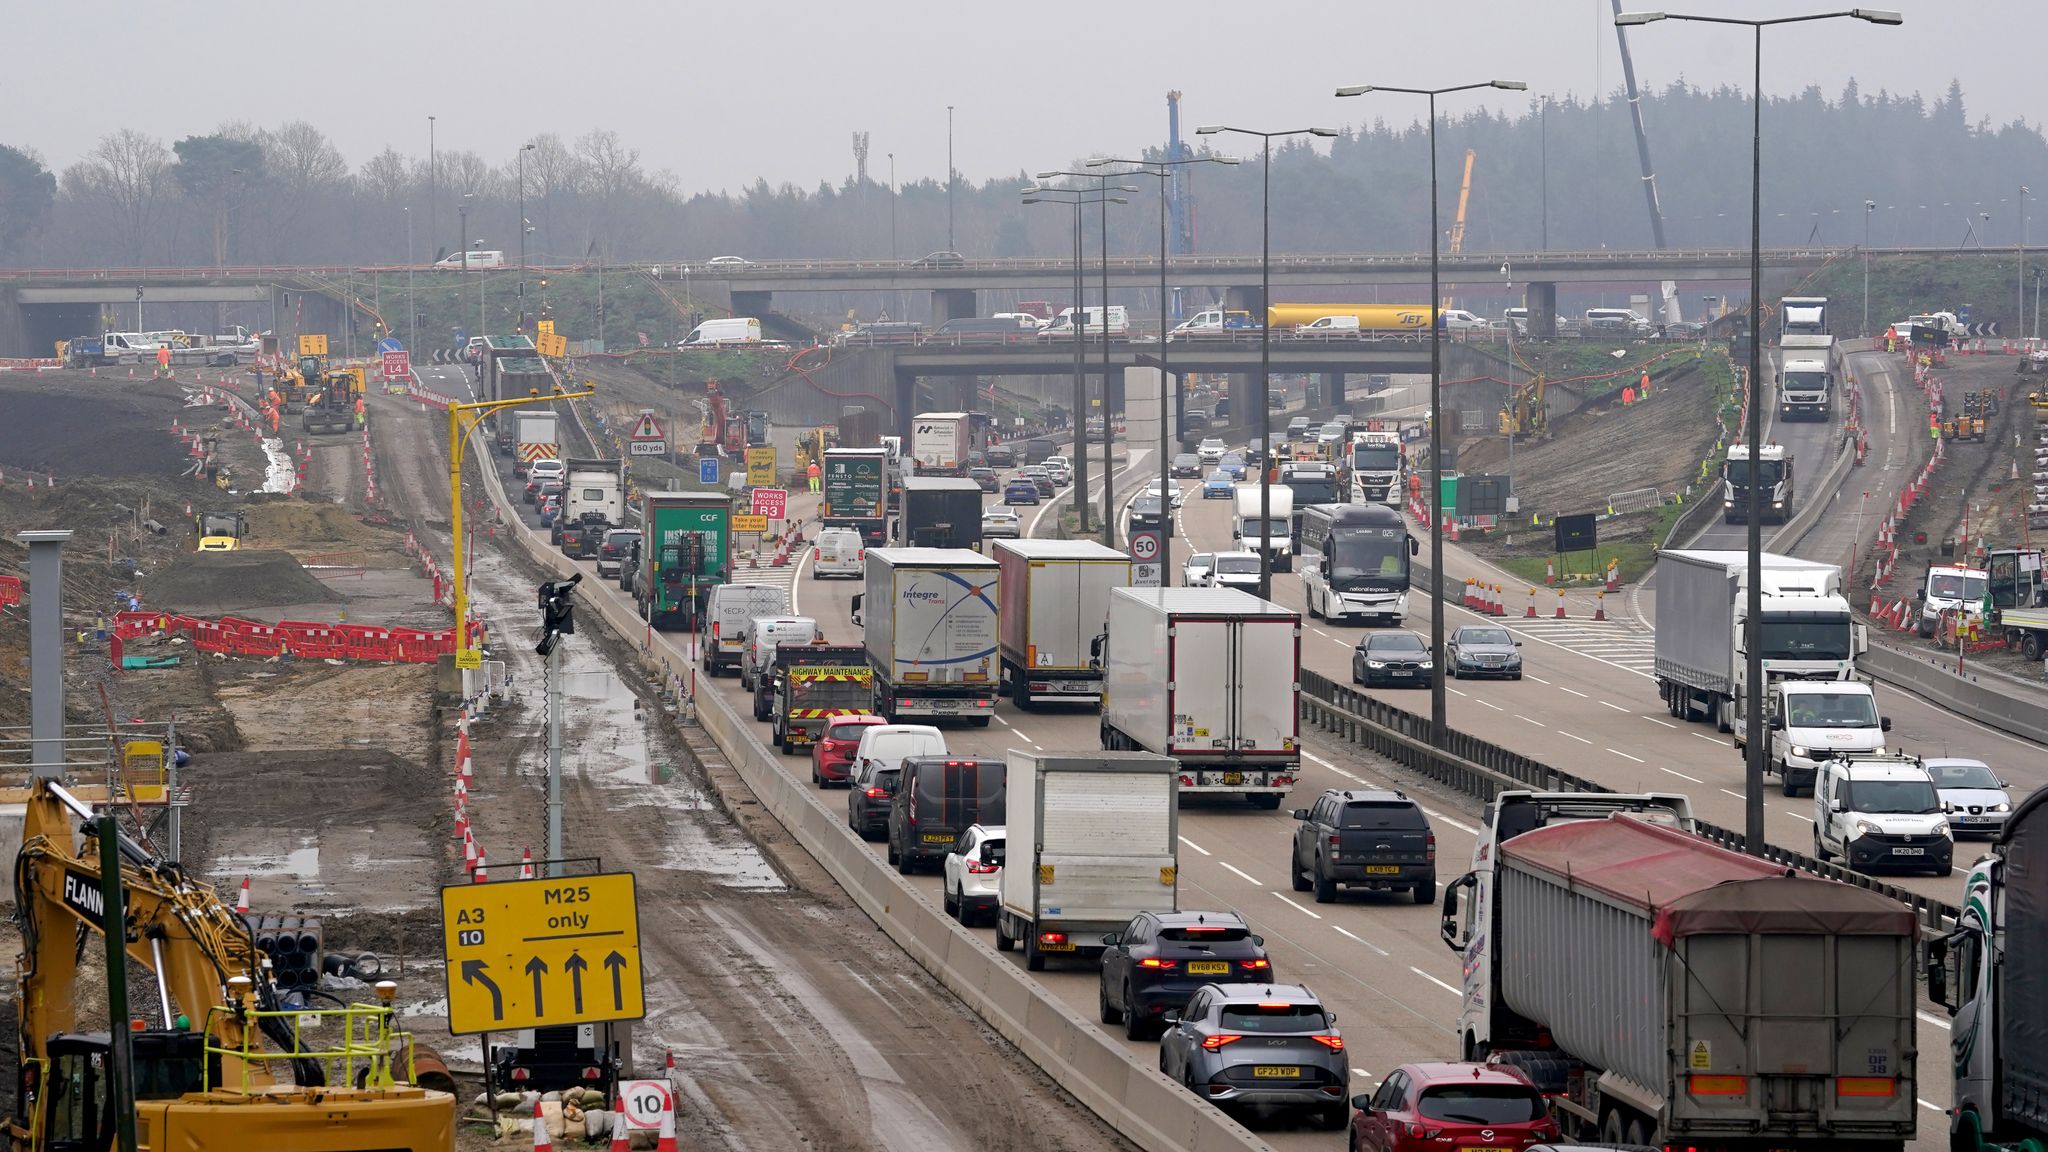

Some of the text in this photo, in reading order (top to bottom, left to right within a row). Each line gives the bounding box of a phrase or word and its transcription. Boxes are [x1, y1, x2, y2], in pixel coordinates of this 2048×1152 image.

[1400, 315, 1423, 324] JET
[390, 365, 402, 374] L4
[760, 506, 778, 516] B3
[1136, 541, 1155, 553] 50
[903, 591, 939, 600] Integre
[1041, 654, 1049, 664] A
[792, 667, 870, 676] HIGHWAY MAINTENANCE
[65, 874, 128, 918] FLANN
[544, 886, 591, 905] M25
[456, 908, 486, 925] A3
[547, 912, 590, 932] only
[460, 931, 482, 944] 10
[1869, 1056, 1886, 1064] DP
[1258, 1068, 1296, 1076] GF23 WDP
[634, 1095, 661, 1114] 10
